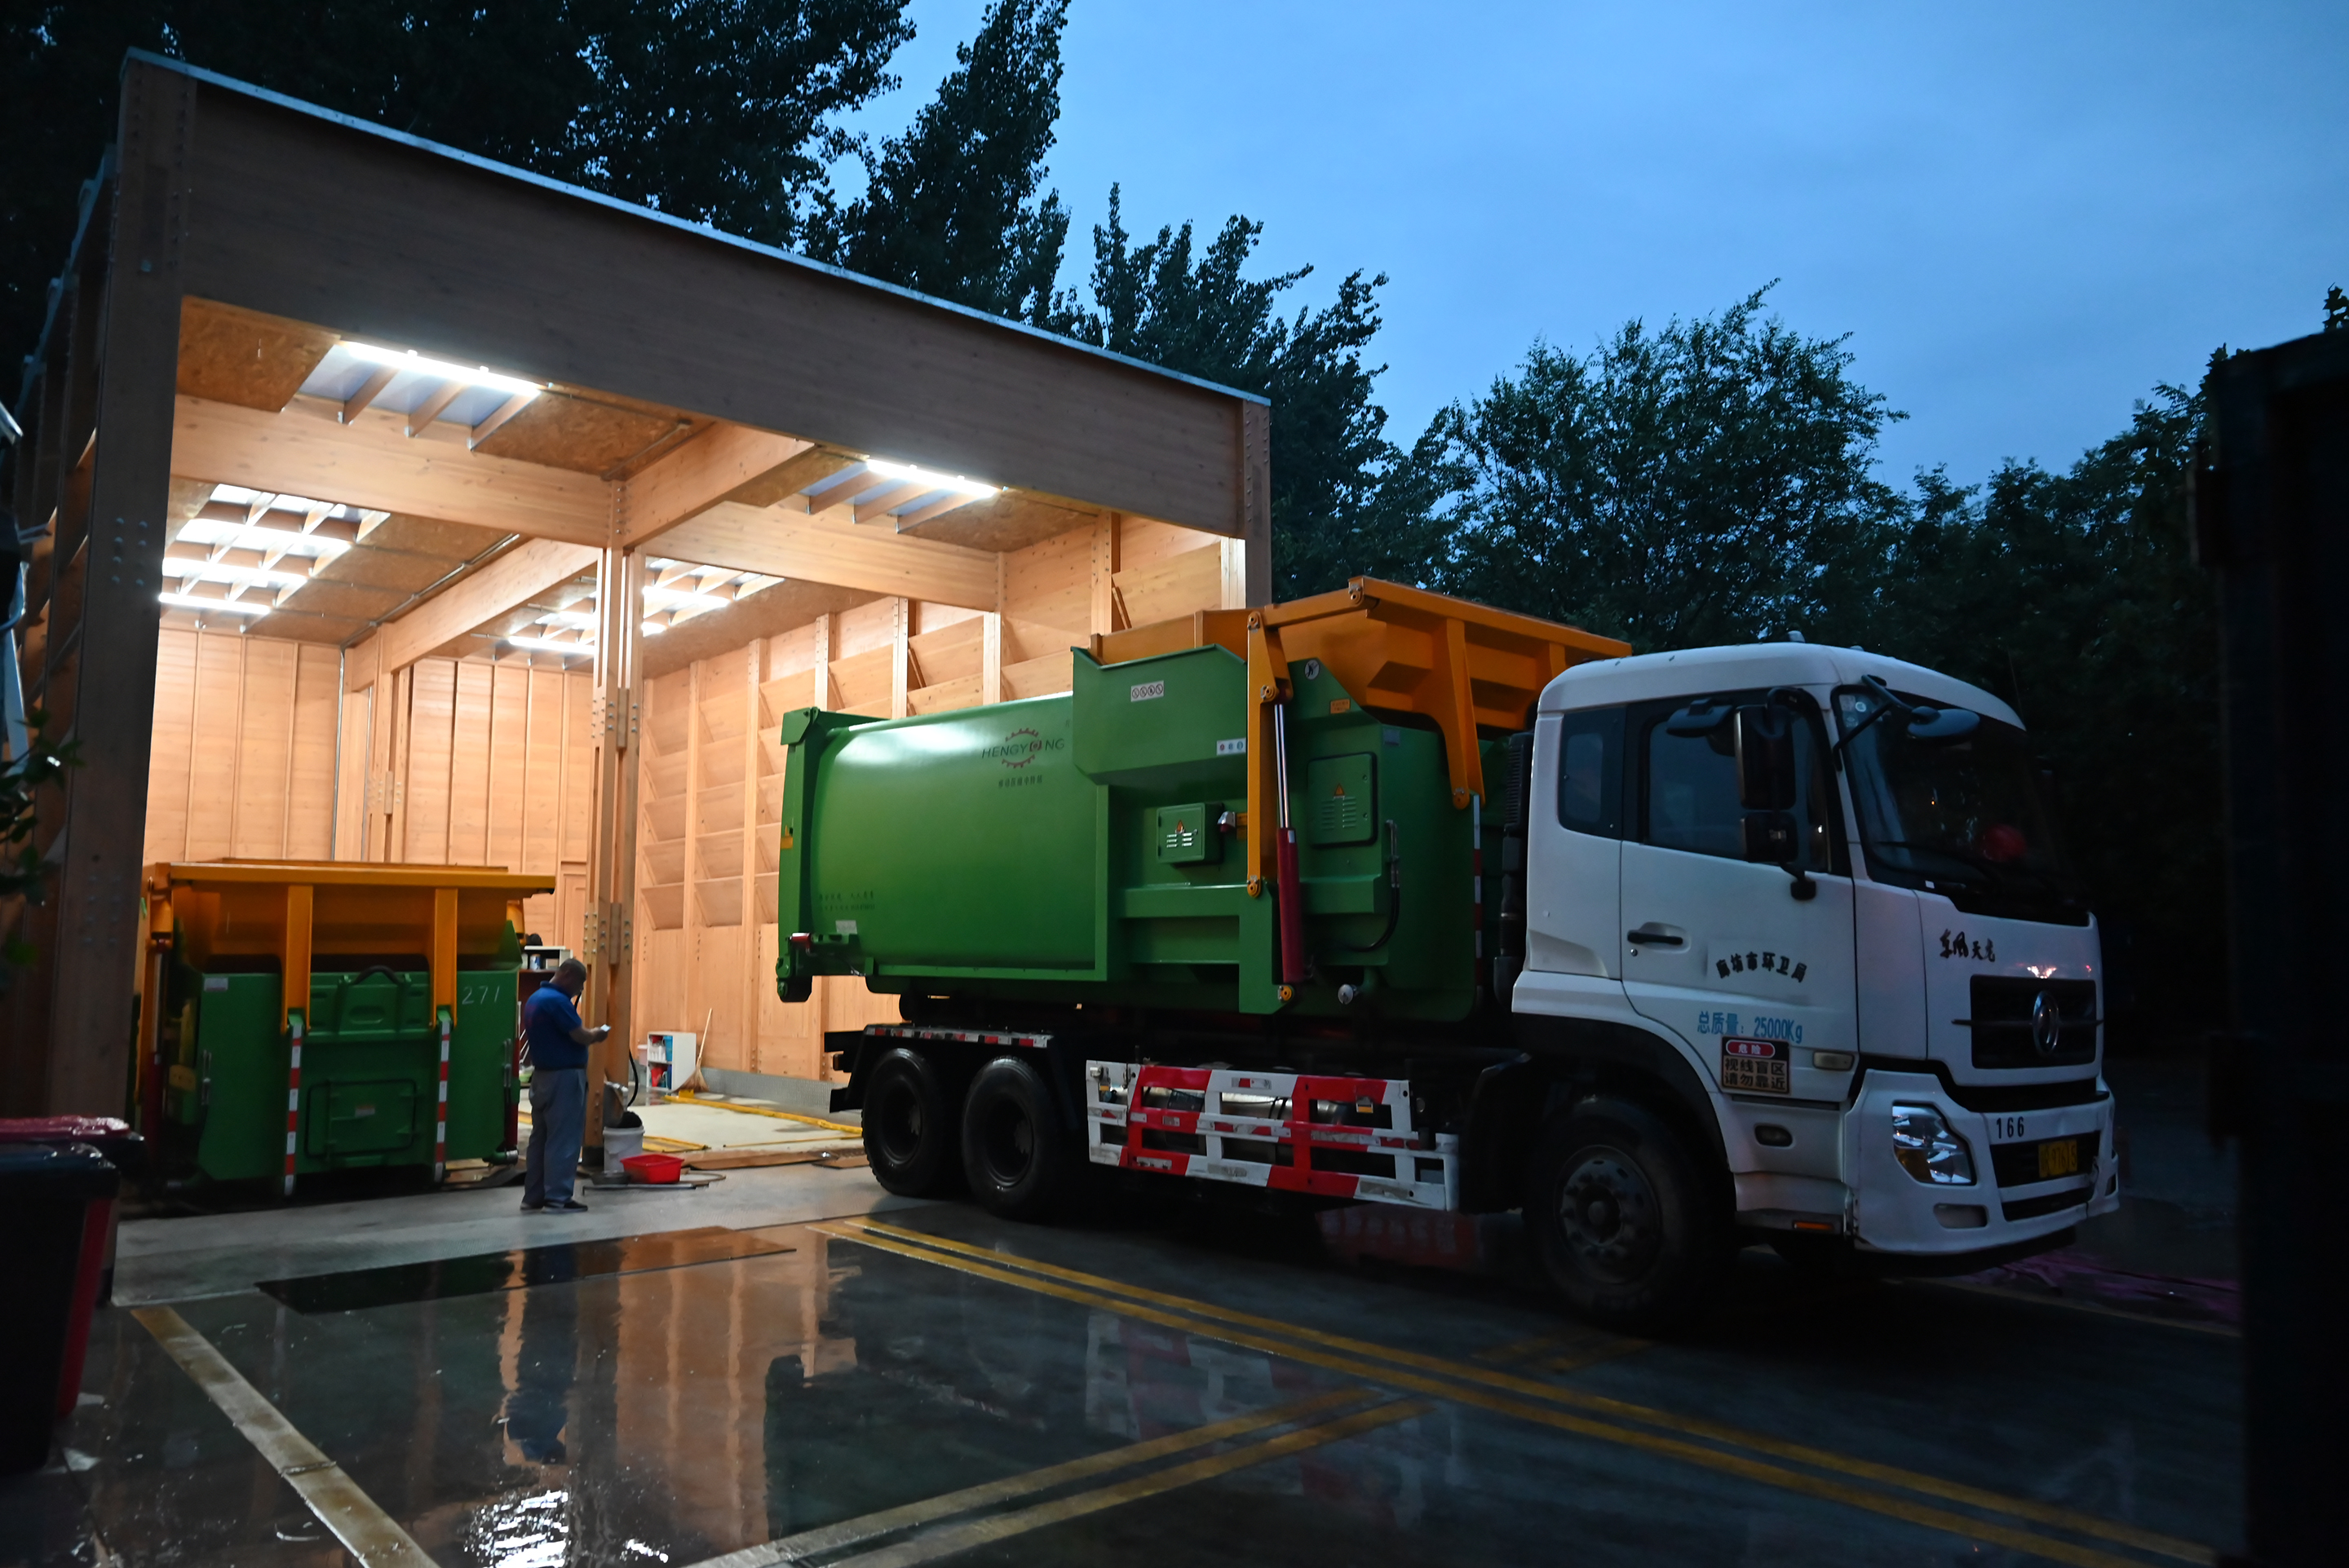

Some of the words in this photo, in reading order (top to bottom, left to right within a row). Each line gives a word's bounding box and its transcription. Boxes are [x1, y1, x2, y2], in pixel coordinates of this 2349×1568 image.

[461, 985, 501, 1005] 271
[1754, 1016, 1803, 1044] 25000Kg
[1738, 1043, 1762, 1055] 危险
[1724, 1057, 1785, 1076] 视线盲区
[1724, 1071, 1785, 1090] 请勿靠近
[1996, 1115, 2024, 1139] 166
